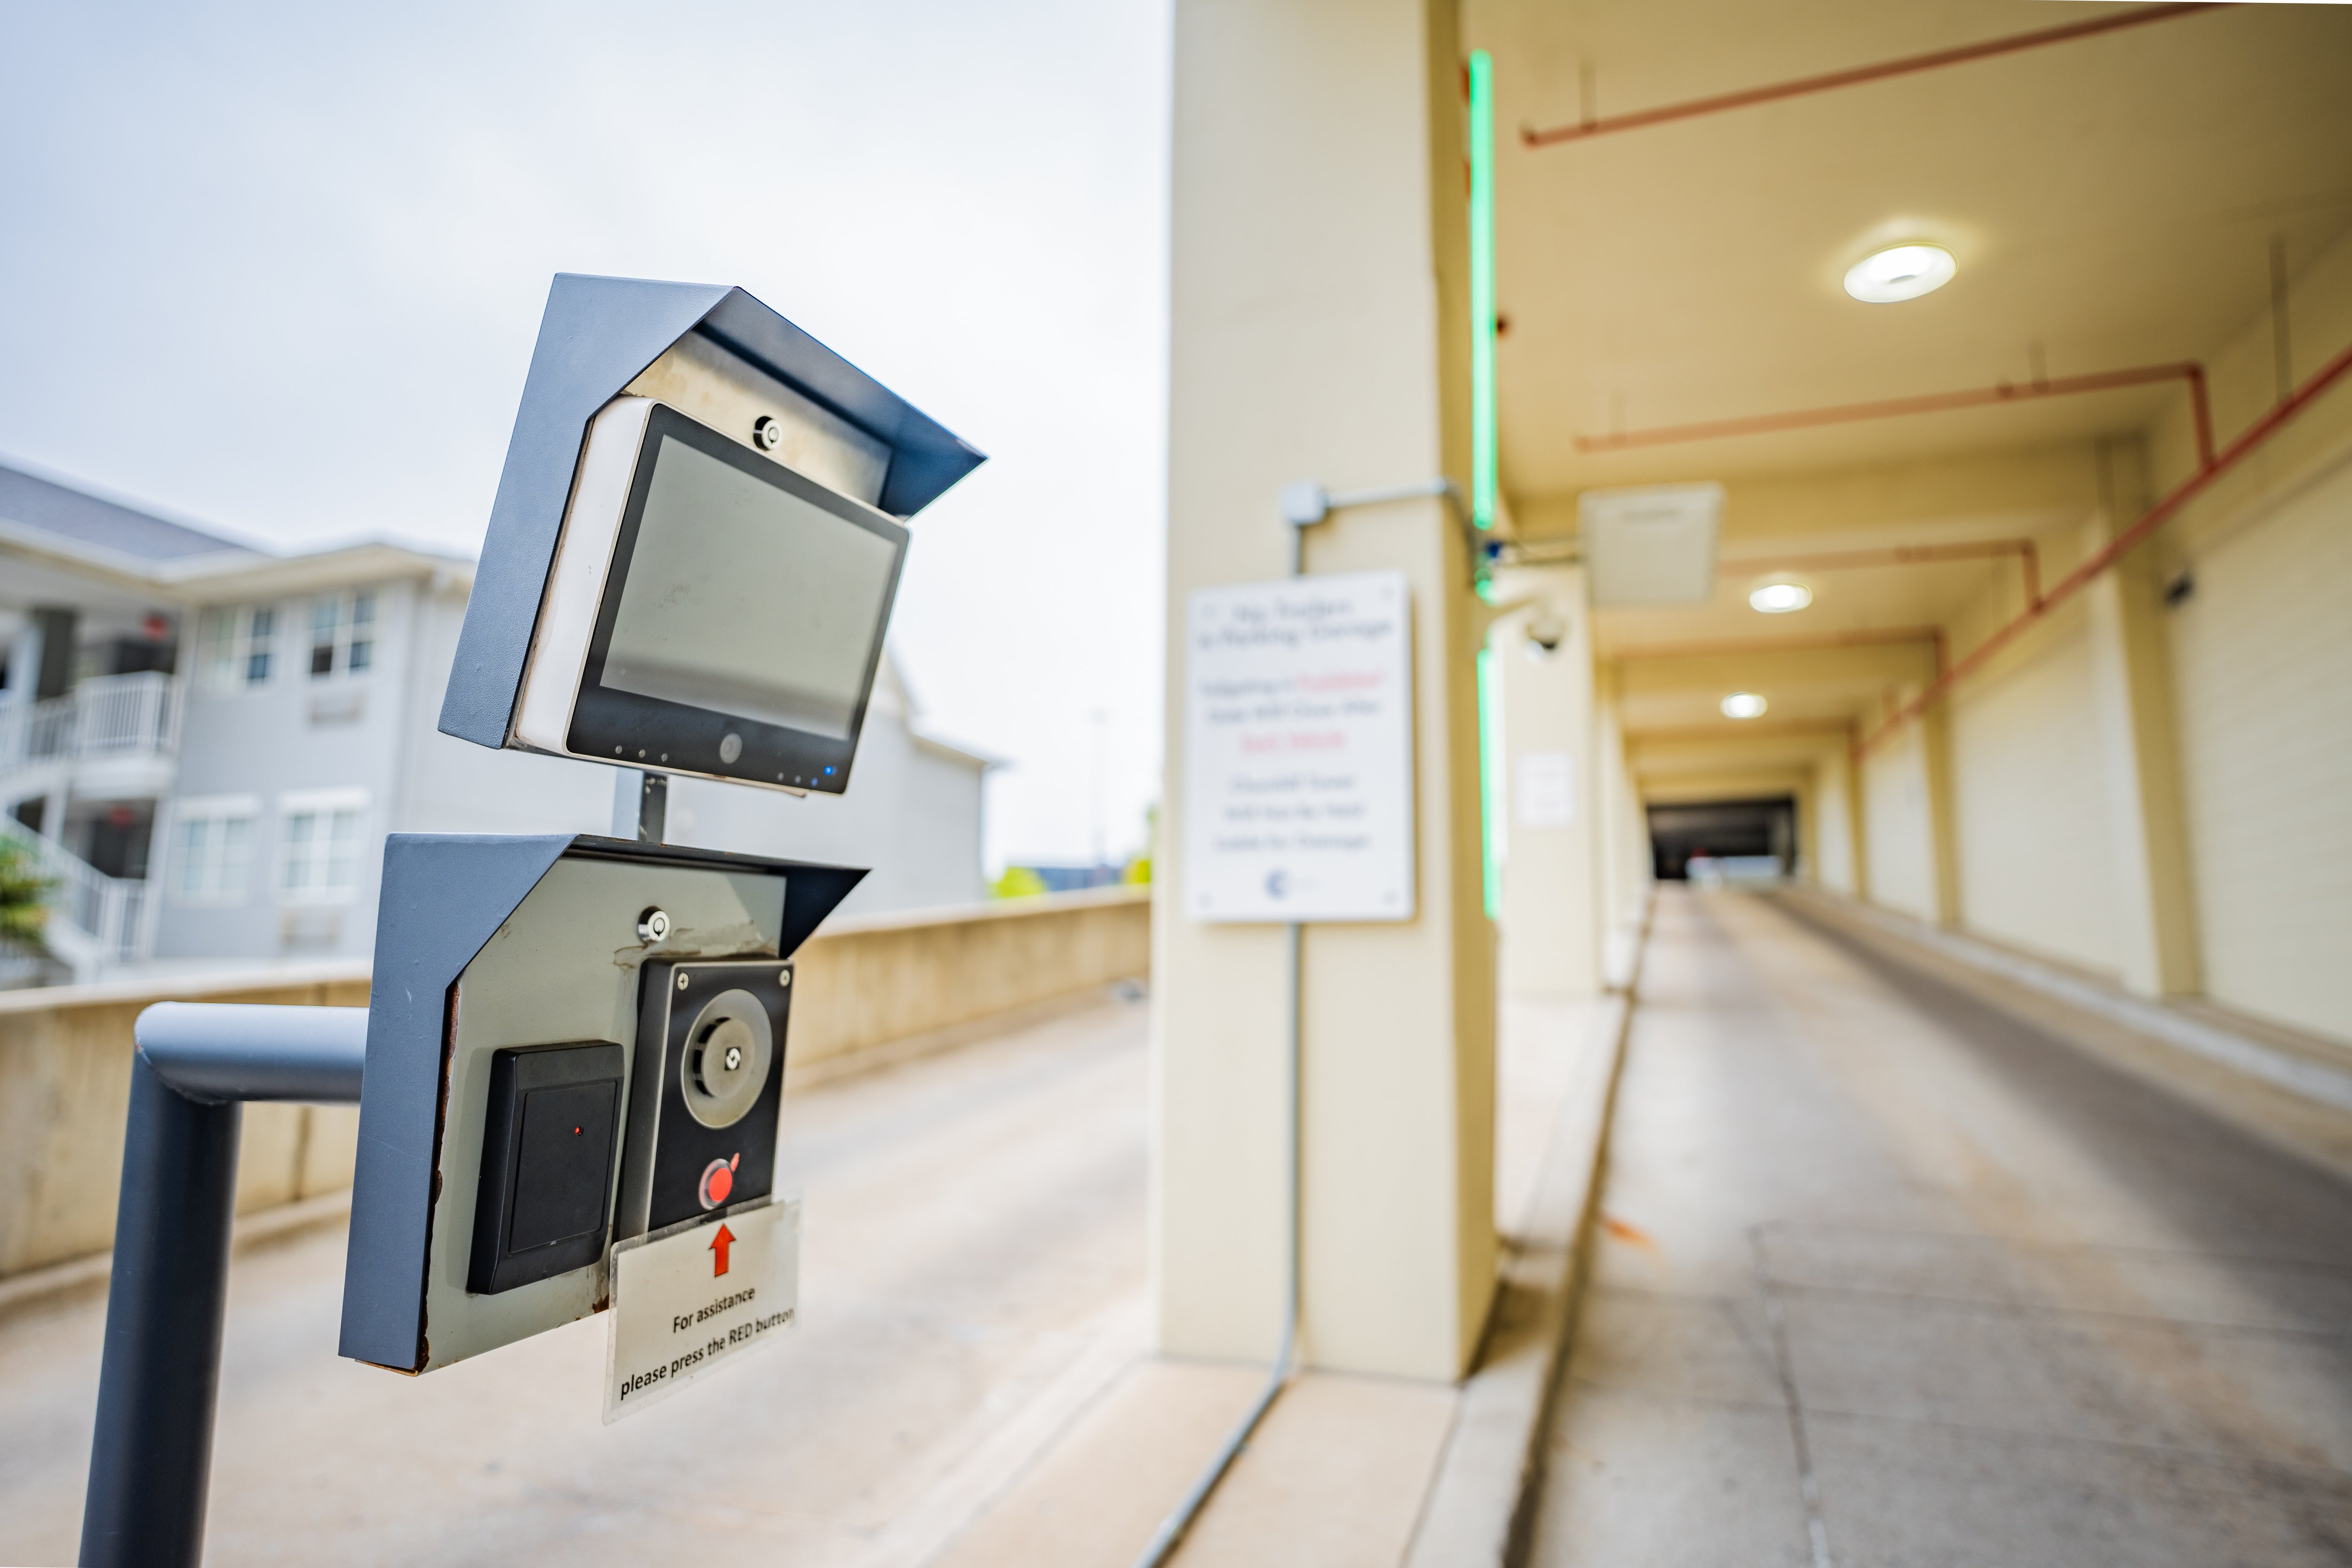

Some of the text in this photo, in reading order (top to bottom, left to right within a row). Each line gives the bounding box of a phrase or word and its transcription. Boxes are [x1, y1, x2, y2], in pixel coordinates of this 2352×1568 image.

[673, 1287, 756, 1333] For assistance
[620, 1307, 795, 1401] please press the RED button
